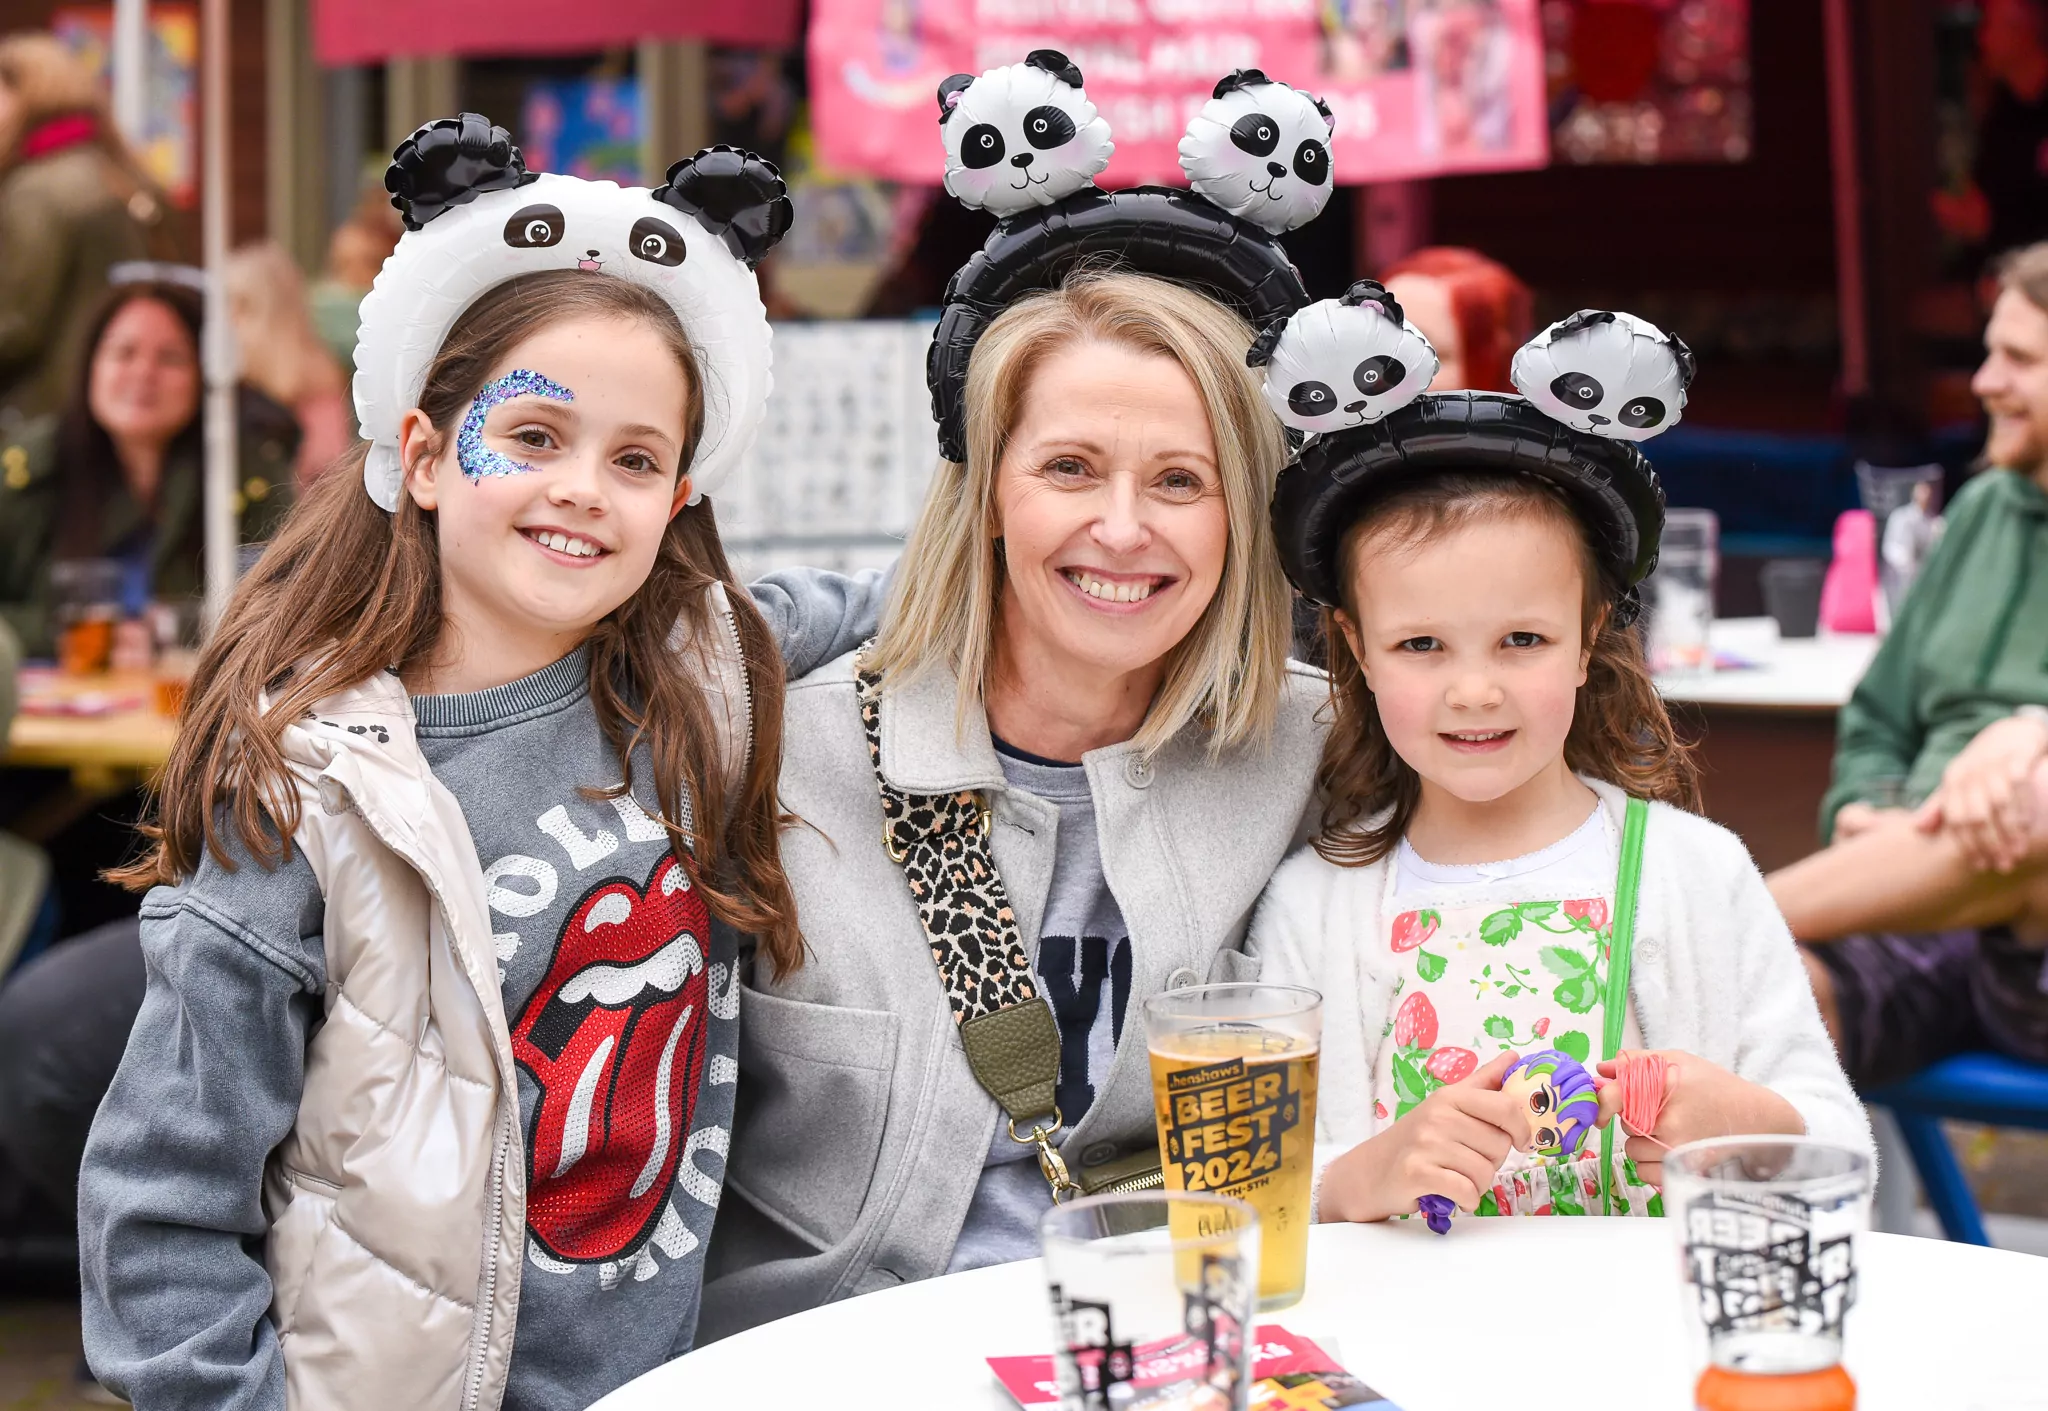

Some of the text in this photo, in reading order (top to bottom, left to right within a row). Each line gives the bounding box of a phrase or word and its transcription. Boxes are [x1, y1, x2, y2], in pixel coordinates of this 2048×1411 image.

[1176, 1072, 1282, 1126] BEER
[1182, 1104, 1278, 1159] FEST
[1184, 1140, 1278, 1192] 2024
